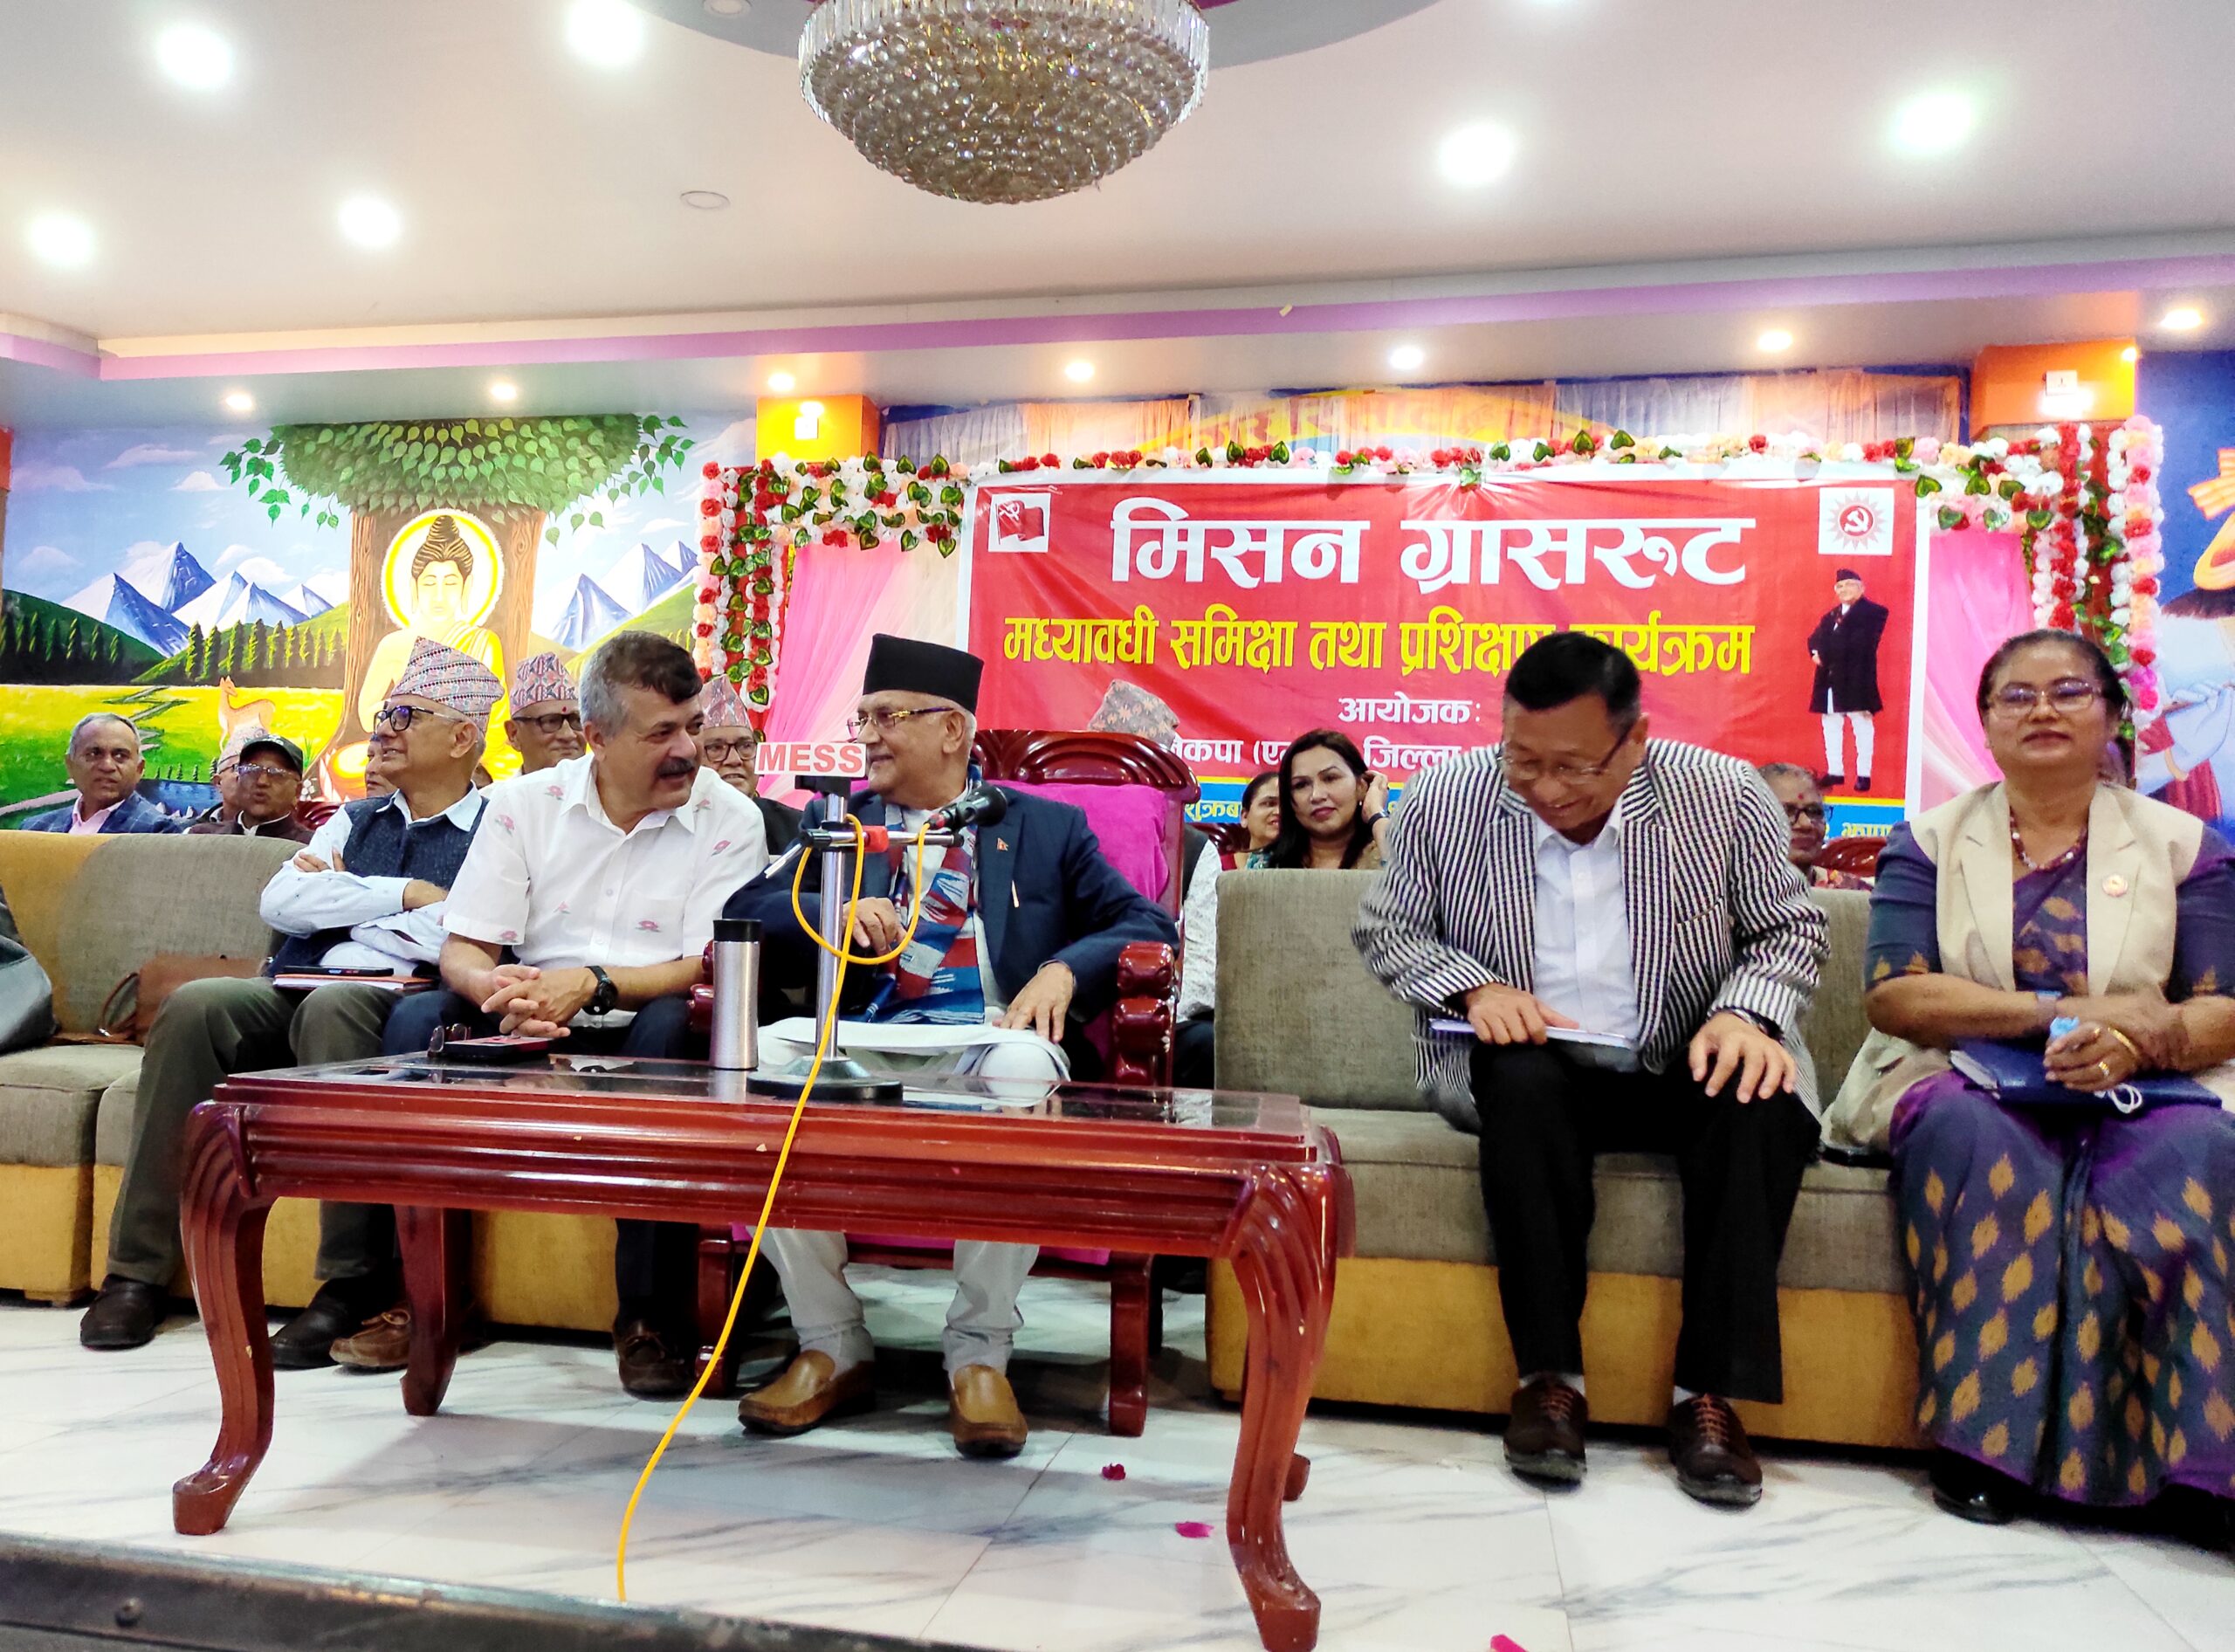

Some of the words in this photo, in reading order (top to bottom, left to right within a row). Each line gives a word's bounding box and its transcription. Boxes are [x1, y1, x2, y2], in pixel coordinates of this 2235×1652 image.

[1111, 497, 1371, 589] मिसन
[1004, 604, 1159, 664] मध्यावधी
[1170, 603, 1298, 674] समिक्षा
[1310, 621, 1386, 671] तथा
[758, 744, 863, 774] MESS
